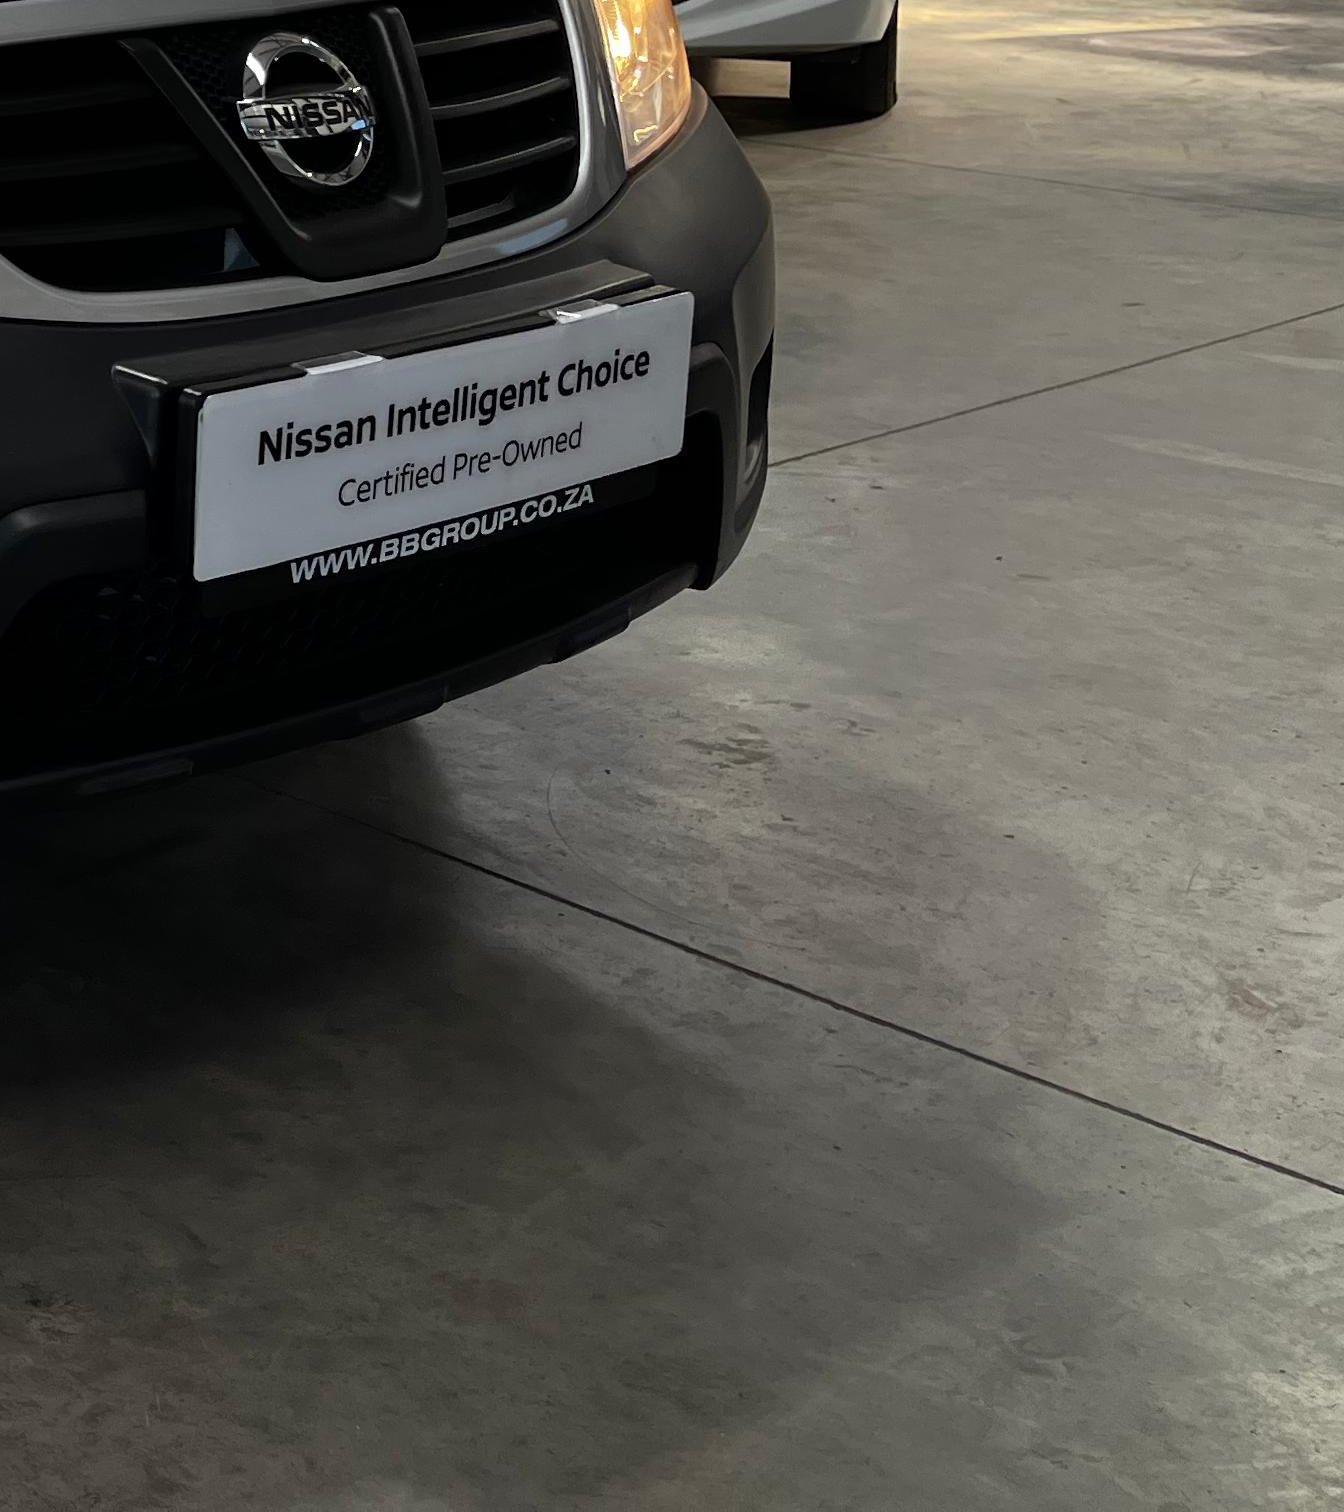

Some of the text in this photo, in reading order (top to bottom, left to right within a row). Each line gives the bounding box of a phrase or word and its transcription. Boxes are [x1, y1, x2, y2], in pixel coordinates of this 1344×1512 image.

[265, 98, 374, 131] NISSAN
[257, 348, 651, 466] Nissan Intelligent Choice
[337, 421, 583, 508] Certified Pre-Owned
[290, 483, 595, 584] WWW.BBGROUP.CO.ZA
